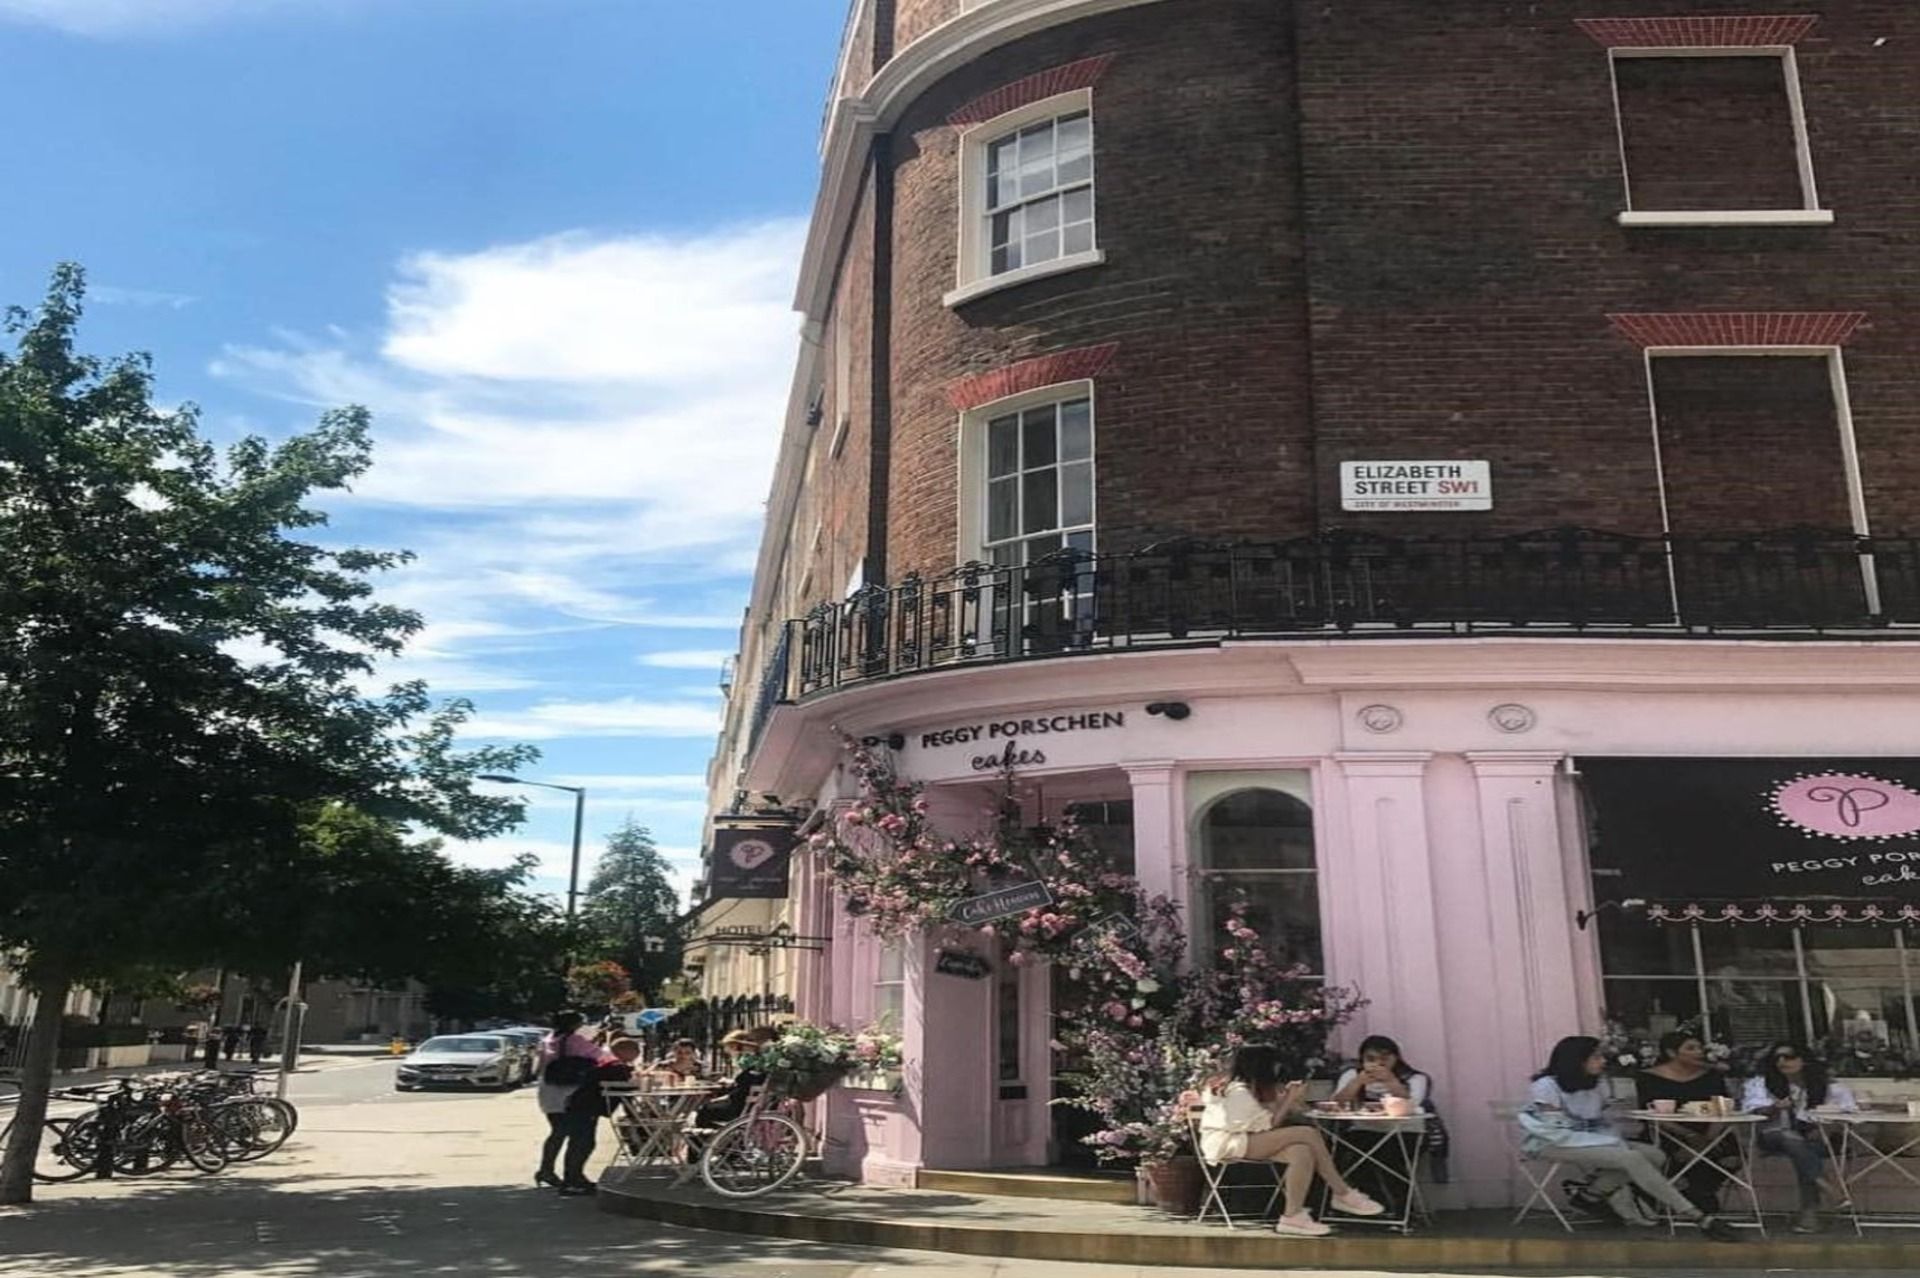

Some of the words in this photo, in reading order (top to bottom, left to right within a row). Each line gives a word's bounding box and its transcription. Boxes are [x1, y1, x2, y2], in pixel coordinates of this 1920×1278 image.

[1354, 465, 1461, 479] ELIZABETH
[1355, 481, 1430, 495] STREET
[1438, 481, 1479, 494] SW1
[922, 725, 984, 749] PEGGY
[989, 711, 1124, 740] PORSCHEN
[971, 740, 1047, 771] cakes
[1771, 857, 1858, 873] PEGGY
[715, 924, 763, 936] HOTEL
